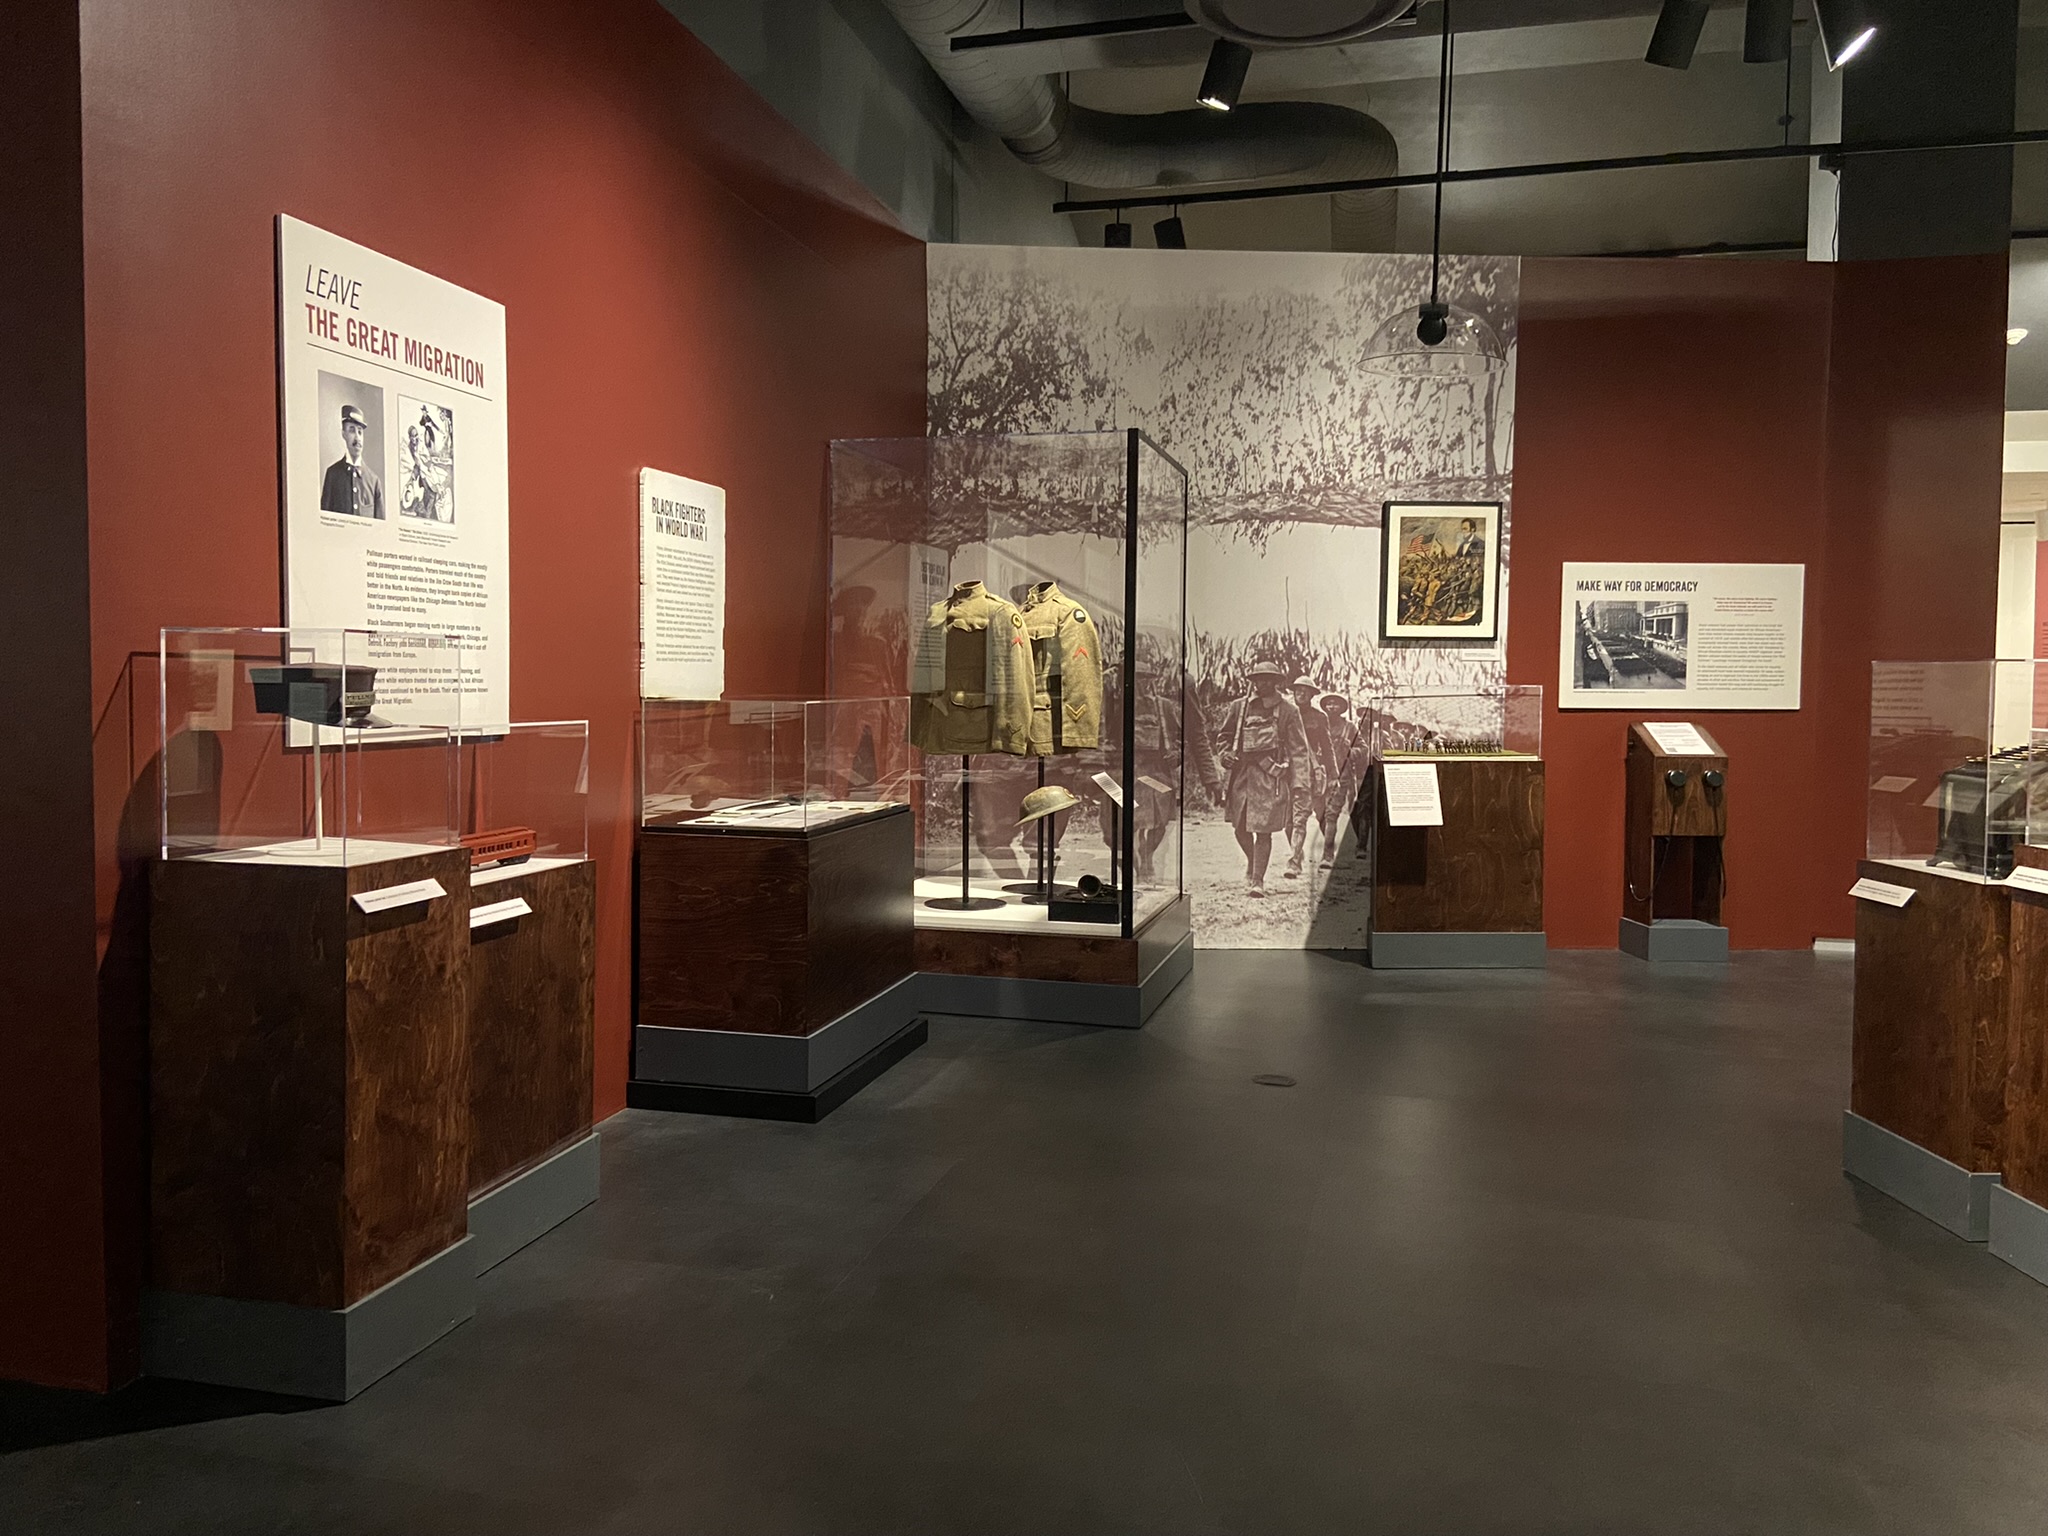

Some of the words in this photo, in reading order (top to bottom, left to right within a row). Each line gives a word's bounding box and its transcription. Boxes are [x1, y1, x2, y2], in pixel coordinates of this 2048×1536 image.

[306, 264, 362, 310] LEAVE
[305, 303, 339, 342] THE
[347, 318, 398, 360] GREAT
[405, 337, 484, 388] MIGRATION
[652, 497, 674, 517] BLACK
[676, 503, 706, 524] FIGHTERS
[656, 517, 664, 534] IN
[666, 520, 688, 538] WORLD
[690, 524, 704, 541] WAR
[705, 526, 707, 542] I
[1576, 581, 1601, 591] MAKE
[1604, 581, 1623, 591] WAY
[1625, 581, 1641, 592] FOR
[1644, 581, 1698, 592] DEMOCRACY
